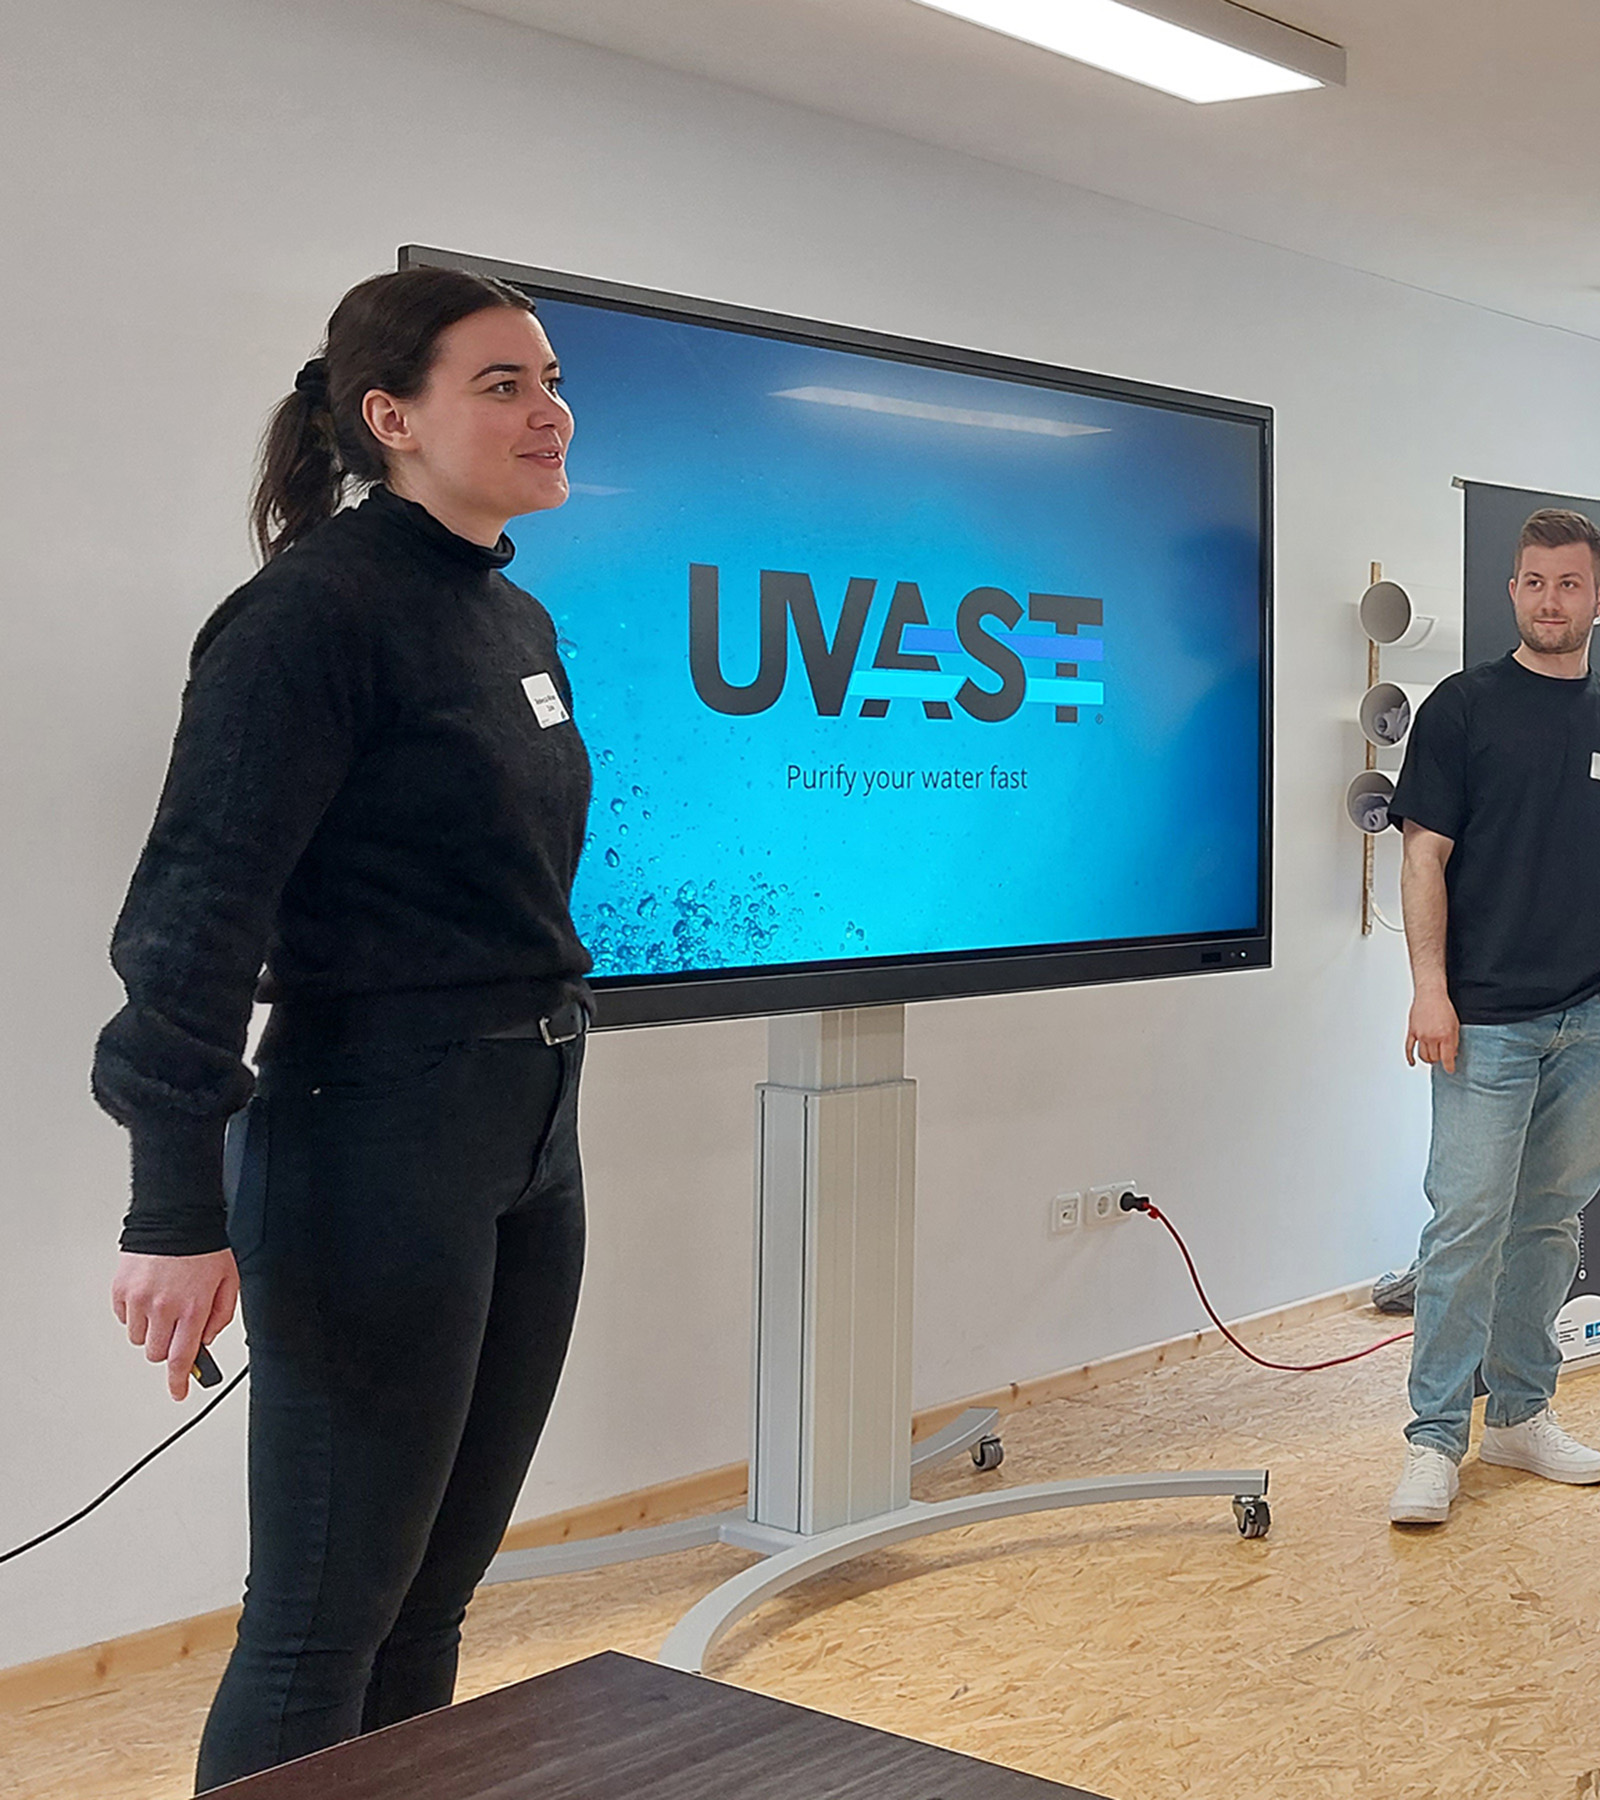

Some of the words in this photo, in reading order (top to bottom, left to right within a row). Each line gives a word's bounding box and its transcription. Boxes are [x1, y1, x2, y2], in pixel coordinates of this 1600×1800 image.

[689, 562, 1104, 725] UVAST
[786, 763, 857, 797] Purify
[863, 769, 915, 797] your
[921, 768, 983, 790] water
[990, 764, 1029, 790] fast
